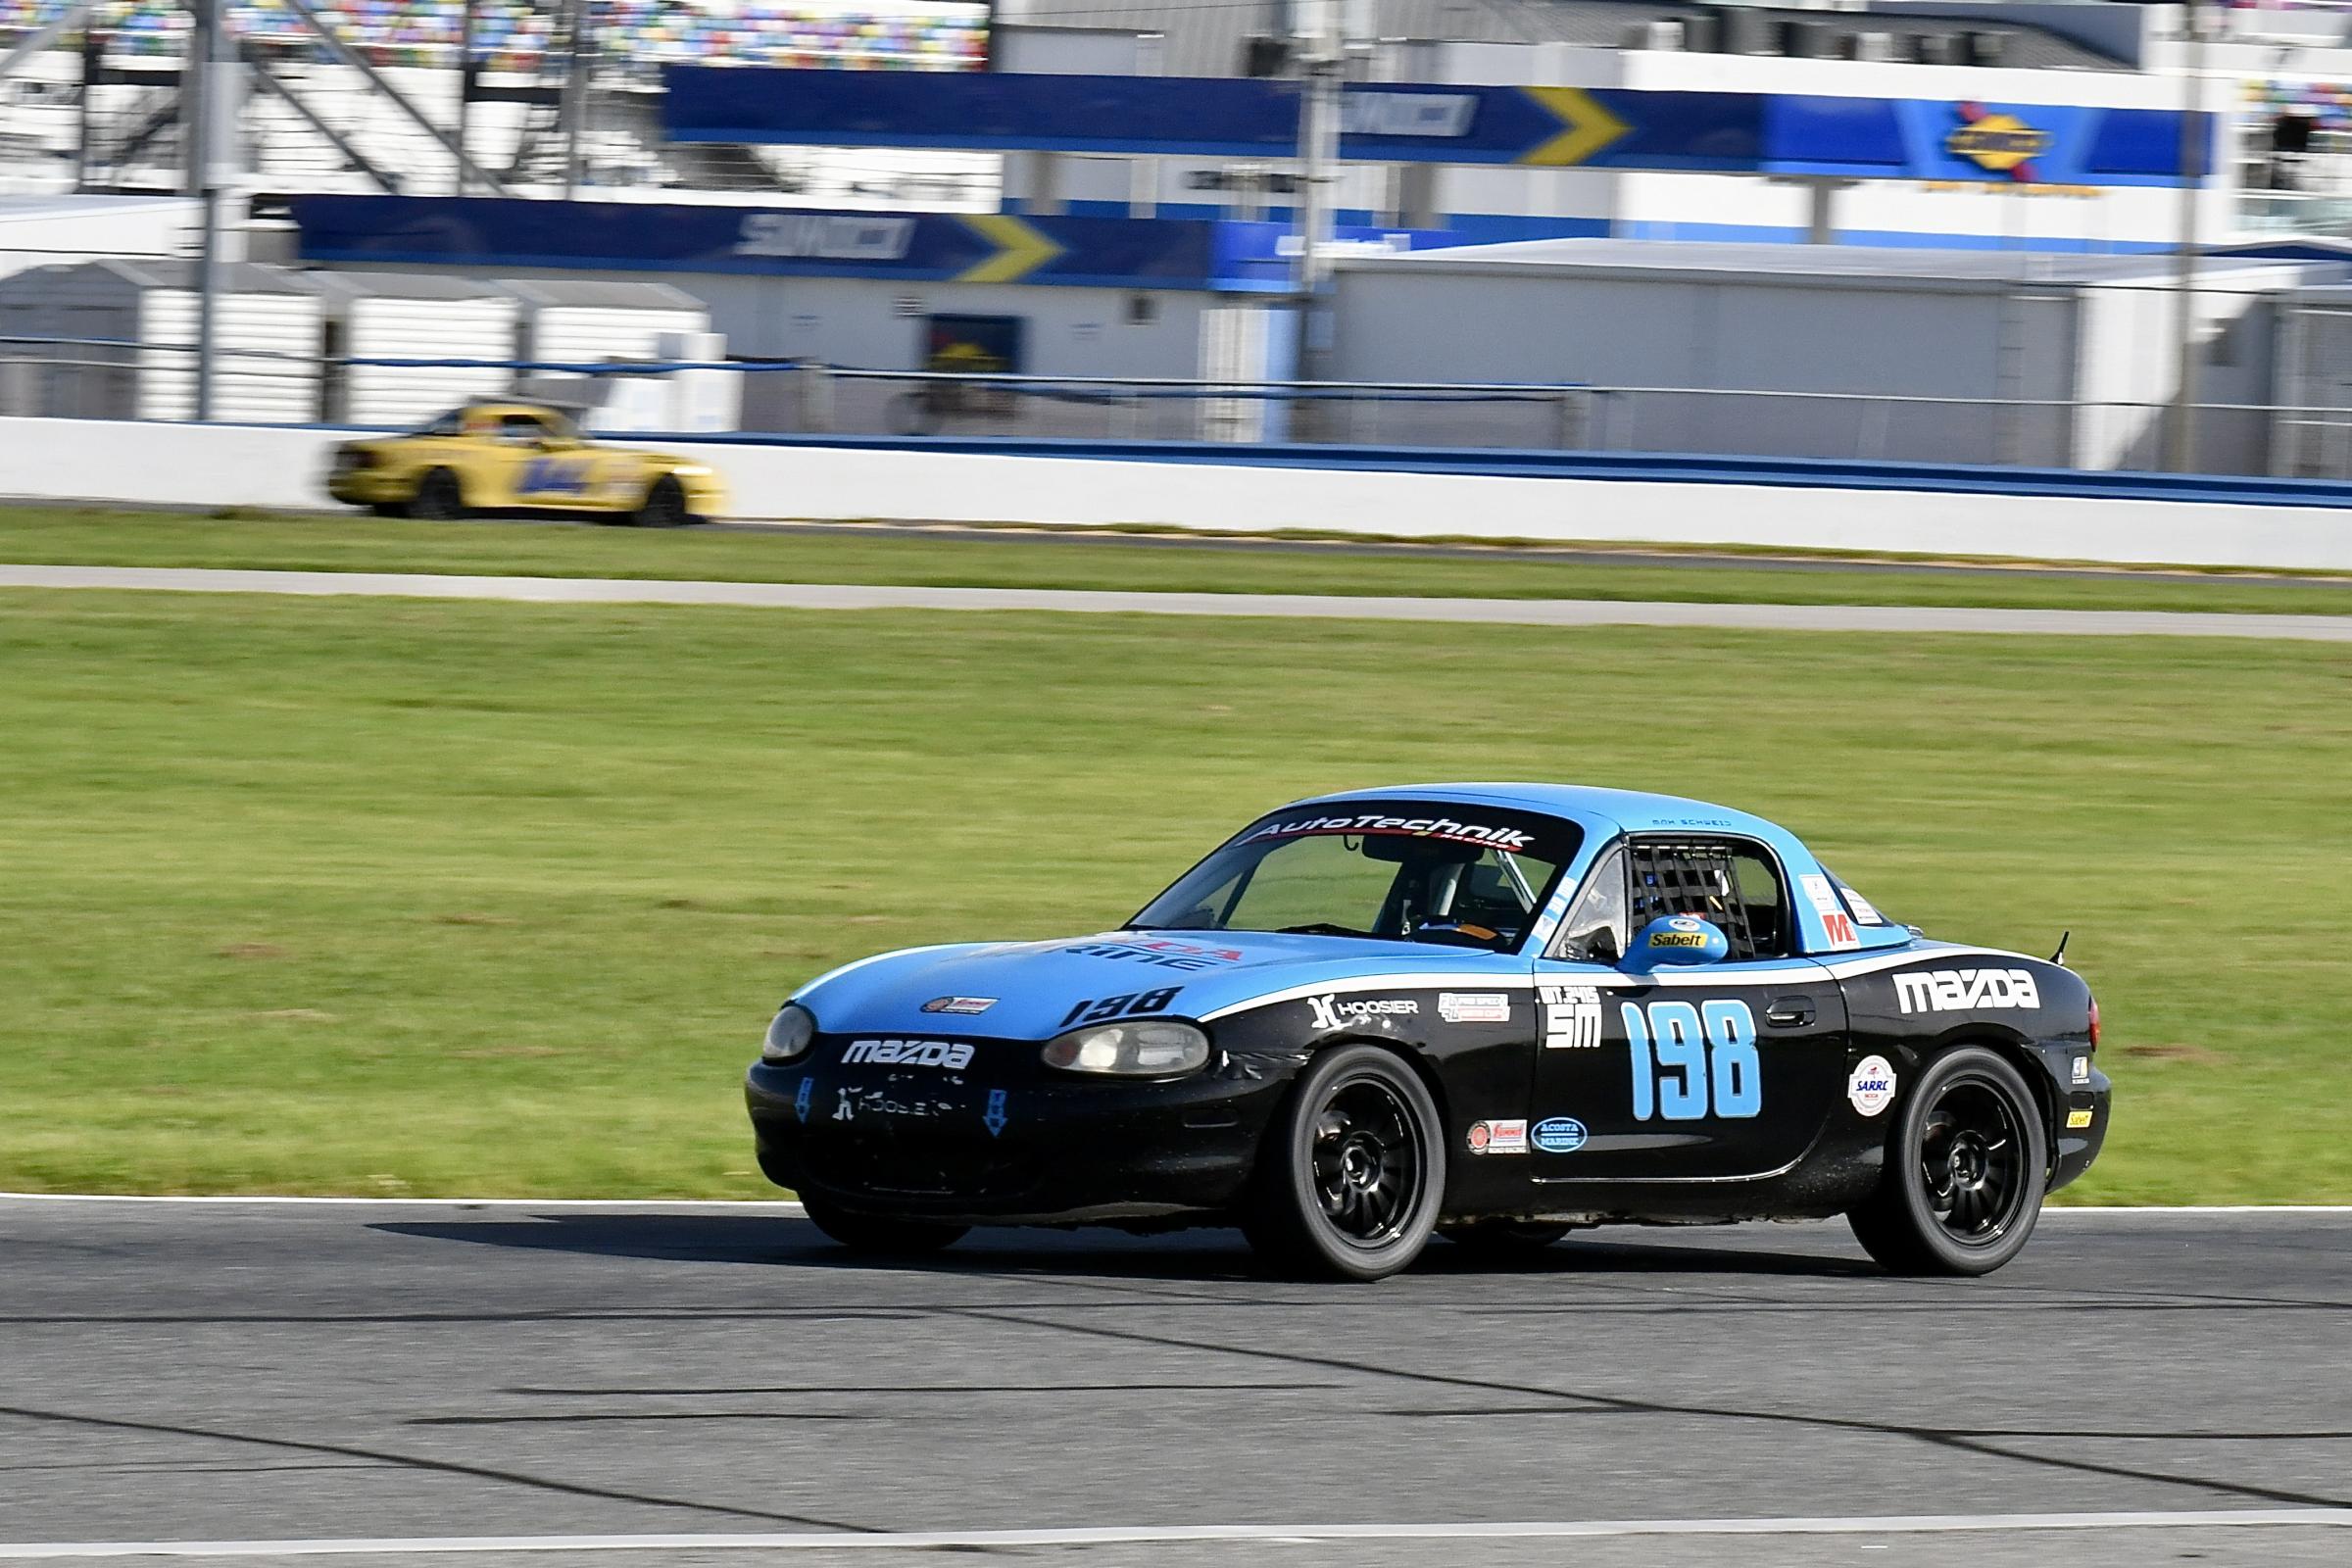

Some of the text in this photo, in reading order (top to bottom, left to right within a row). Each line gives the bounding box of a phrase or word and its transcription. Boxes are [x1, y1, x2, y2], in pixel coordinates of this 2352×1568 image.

[1236, 815, 1536, 848] AutoTechnik
[1652, 933, 1702, 947] Sabelt
[1059, 986, 1186, 1027] 198
[1338, 1000, 1419, 1016] HOOSIER
[1545, 1004, 1602, 1049] SM
[1620, 999, 1762, 1121] 198
[1855, 1080, 1889, 1092] SARRC
[1541, 1123, 1579, 1132] ACOSTA
